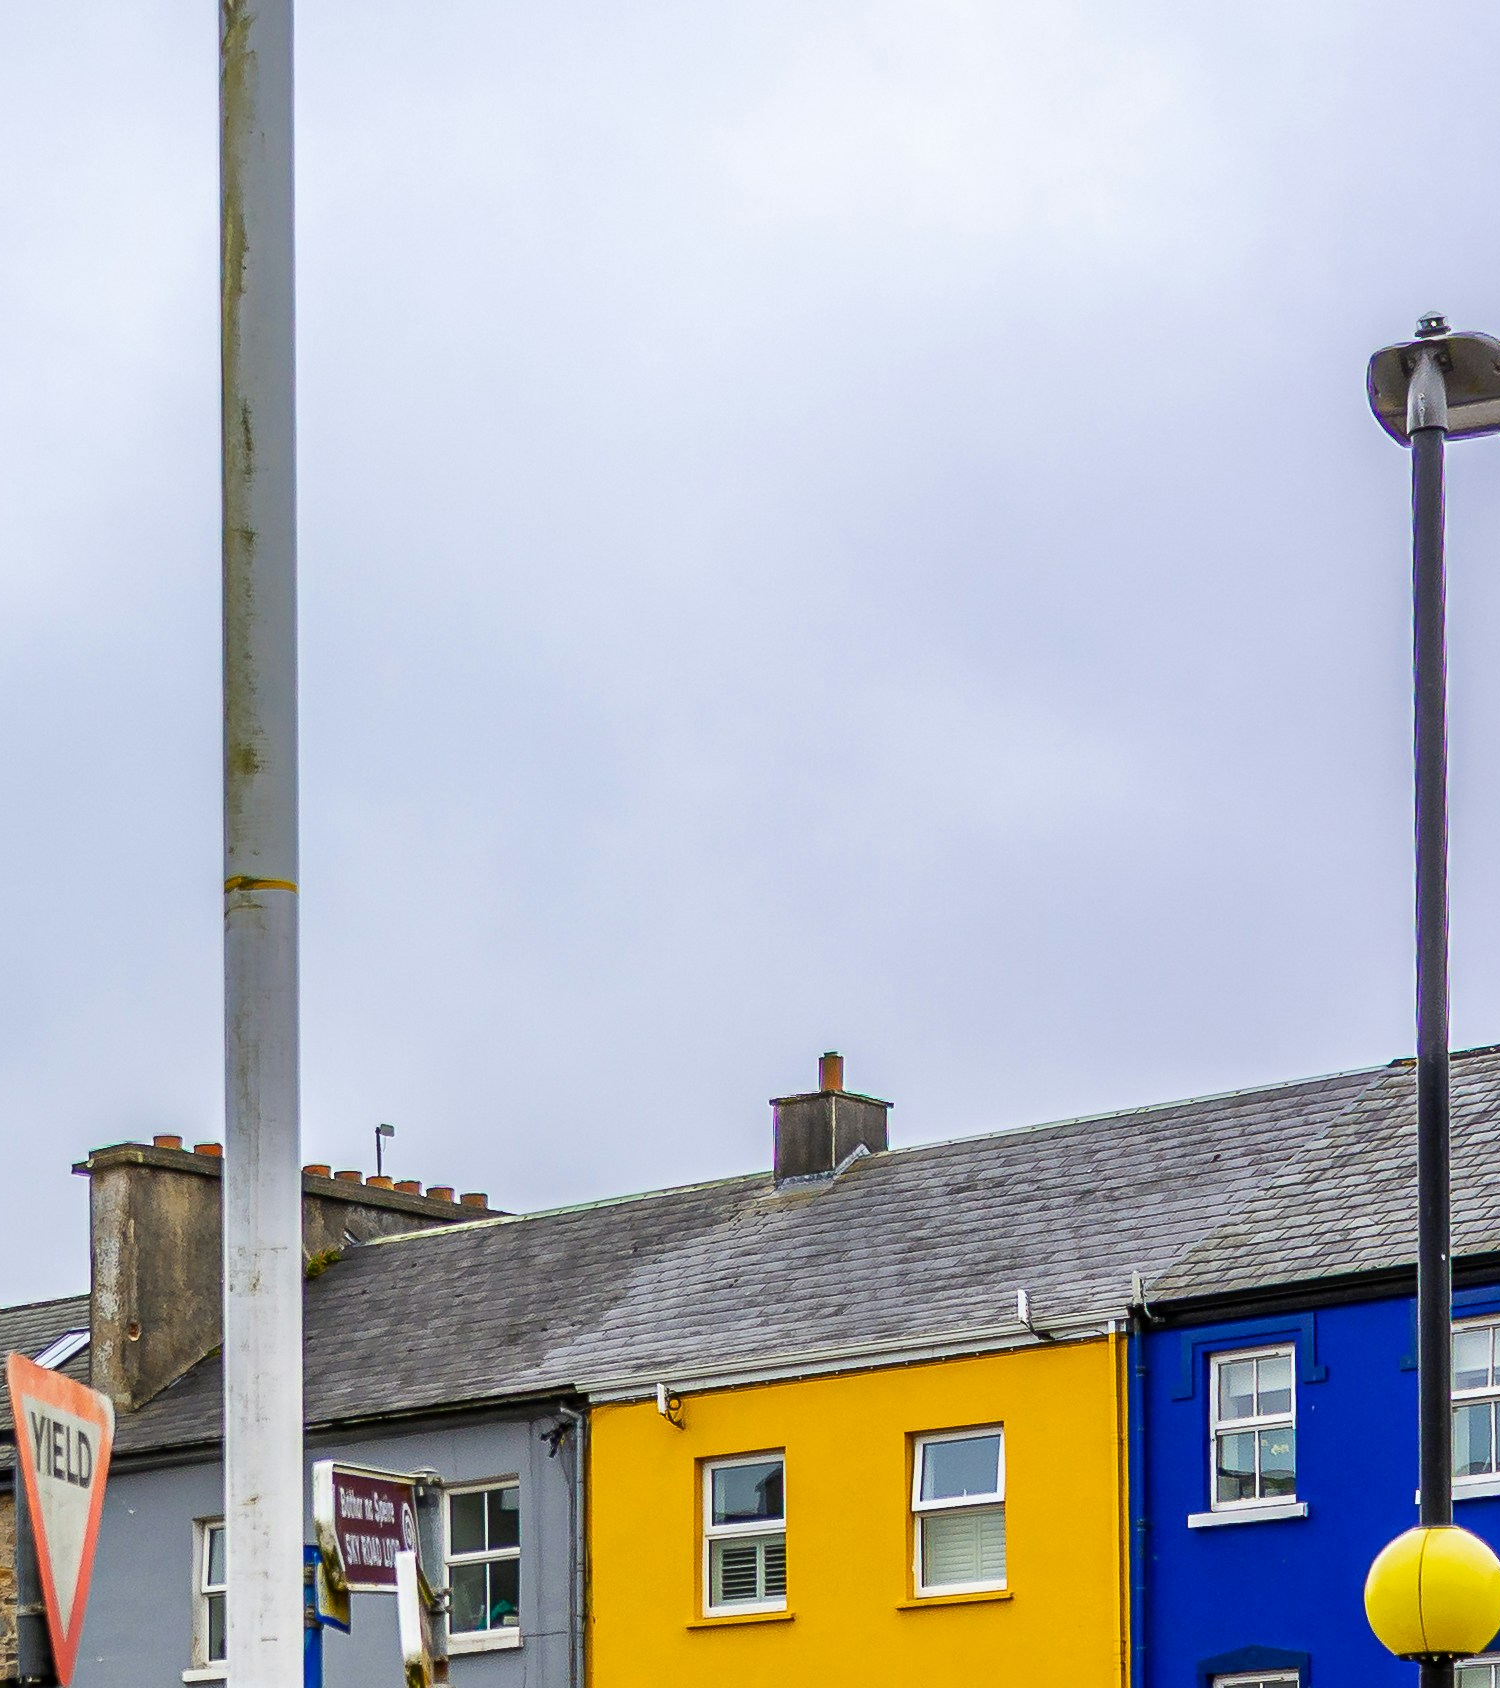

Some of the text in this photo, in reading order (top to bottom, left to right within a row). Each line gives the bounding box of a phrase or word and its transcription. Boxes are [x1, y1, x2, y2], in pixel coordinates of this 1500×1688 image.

[31, 1411, 92, 1489] YIELD
[364, 1499, 374, 1520] na
[345, 1533, 361, 1565] SKY
[361, 1535, 382, 1567] ROAD
